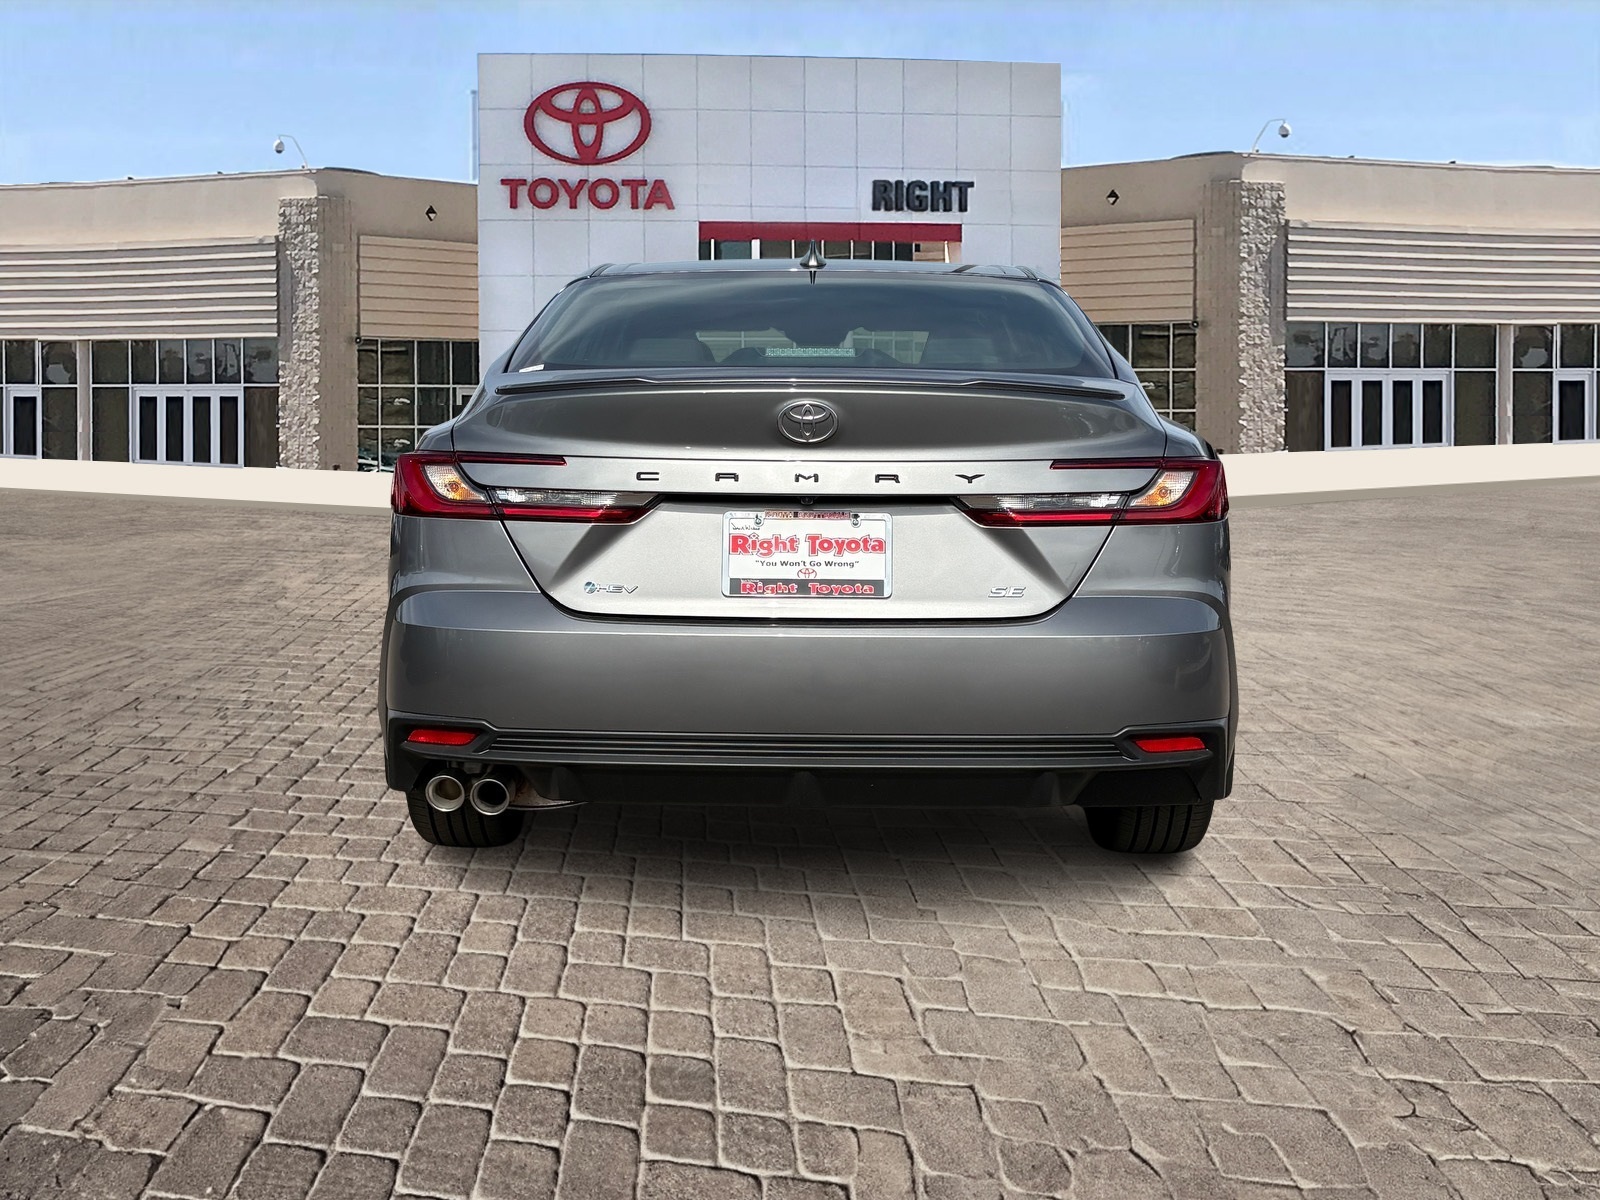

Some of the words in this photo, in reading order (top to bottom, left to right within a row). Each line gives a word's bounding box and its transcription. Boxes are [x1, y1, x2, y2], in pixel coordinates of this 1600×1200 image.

[500, 178, 675, 210] TOYOTA
[870, 179, 975, 213] RIGHT
[635, 471, 986, 484] CAMRY
[729, 533, 800, 557] Right
[805, 533, 886, 557] Toyota
[755, 559, 777, 568] "You
[780, 559, 807, 568] Won't
[809, 559, 822, 568] Go
[824, 559, 860, 569] Wrong"
[596, 584, 639, 594] HEV
[740, 582, 798, 595] Right
[808, 582, 875, 595] Toyota
[987, 585, 1027, 598] SE
